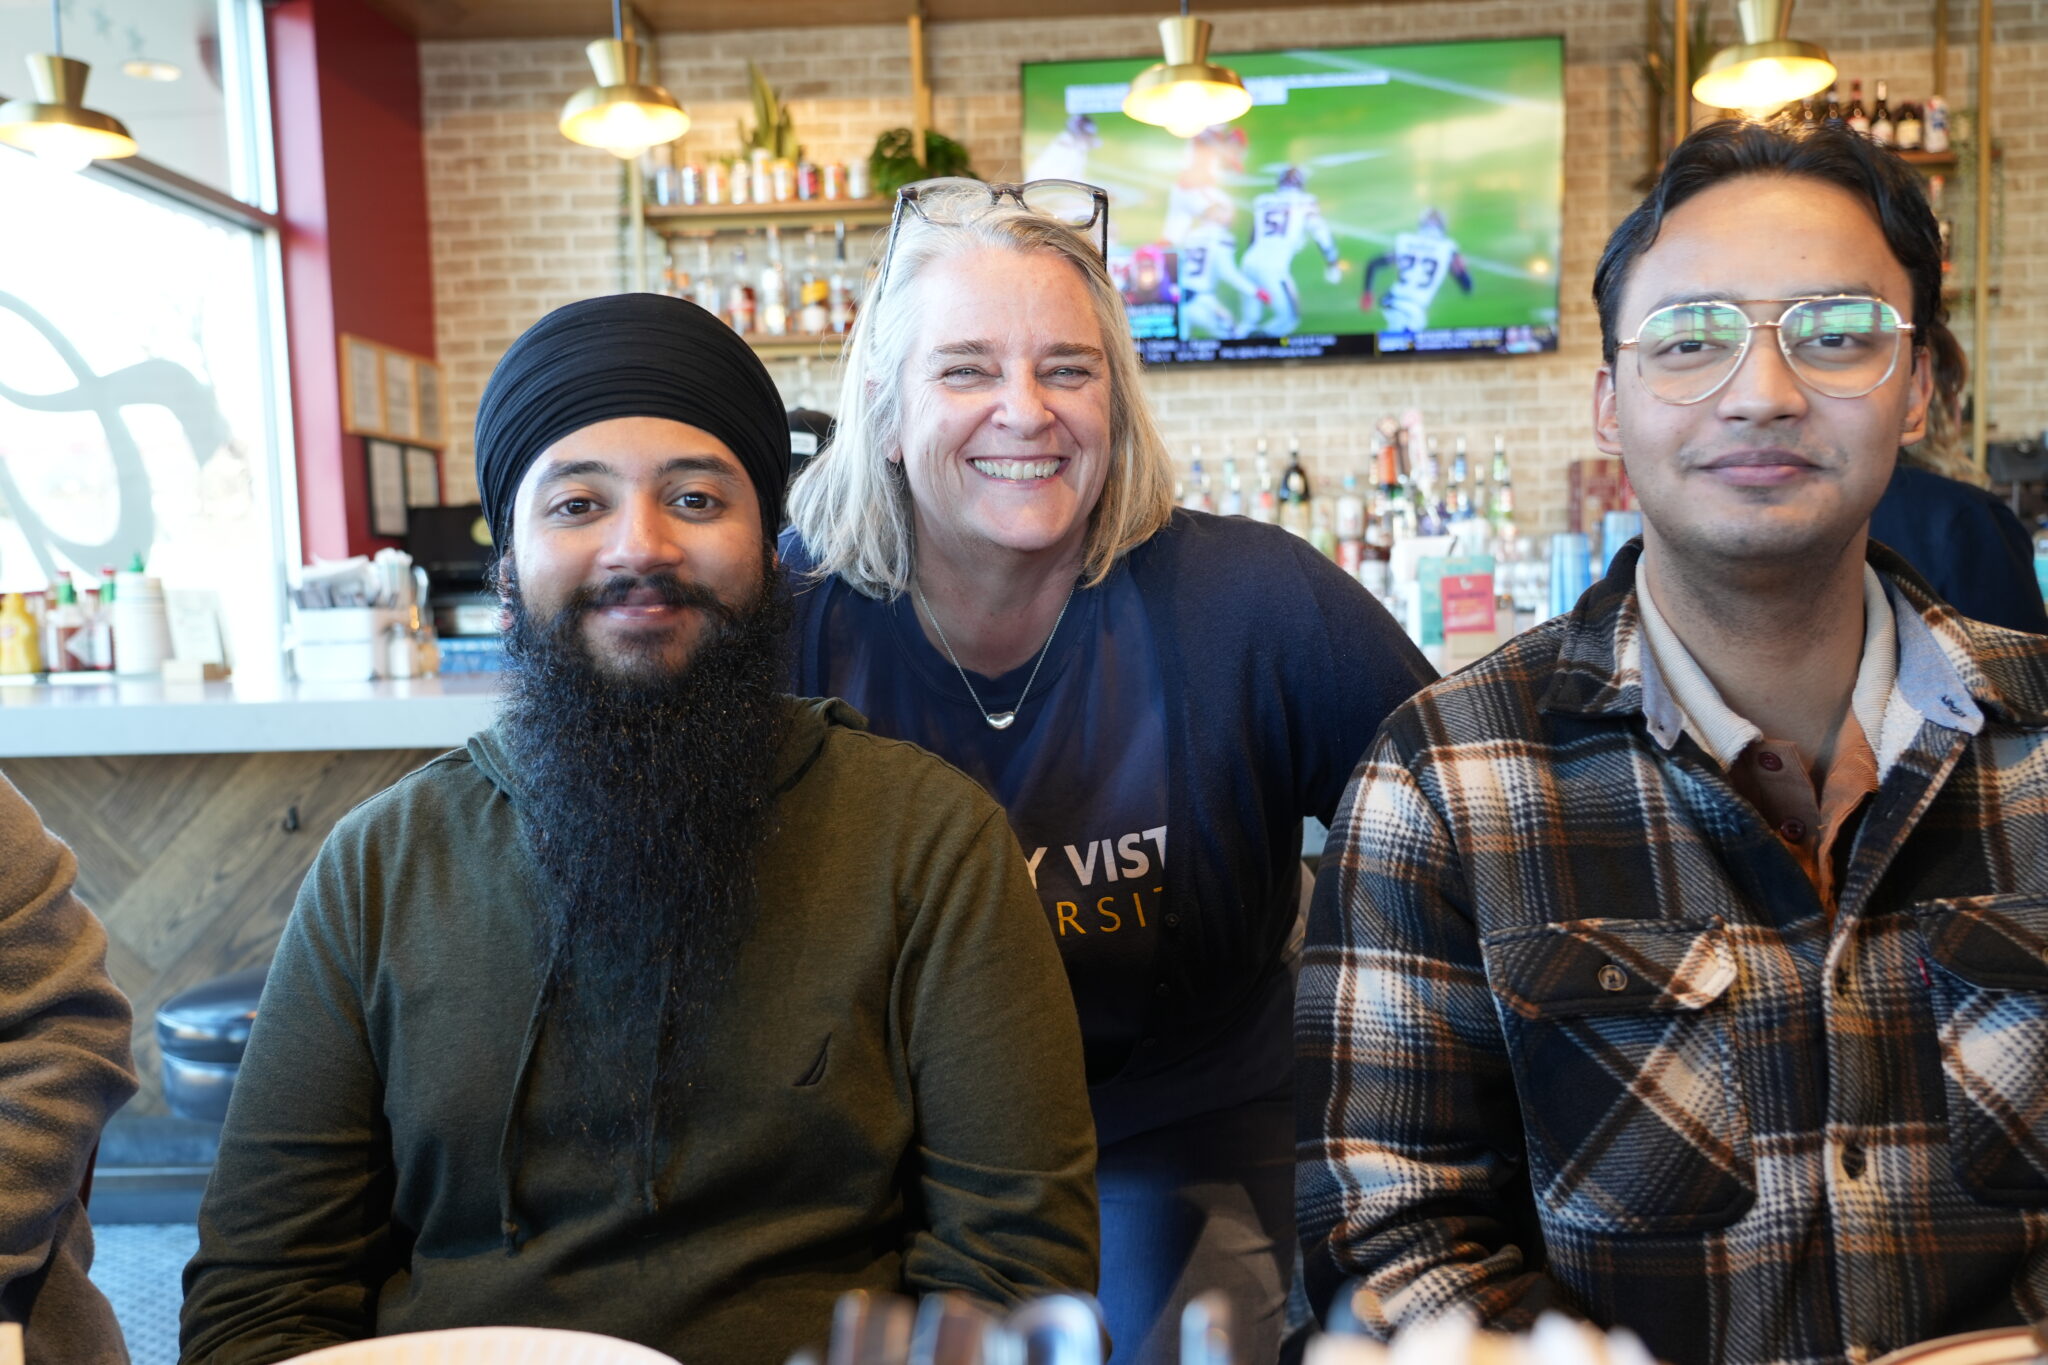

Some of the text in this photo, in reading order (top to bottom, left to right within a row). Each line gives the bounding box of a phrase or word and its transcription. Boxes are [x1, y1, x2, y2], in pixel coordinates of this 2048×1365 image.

[1264, 210, 1289, 236] 51
[1395, 254, 1438, 289] 23
[1056, 886, 1164, 937] RSI
